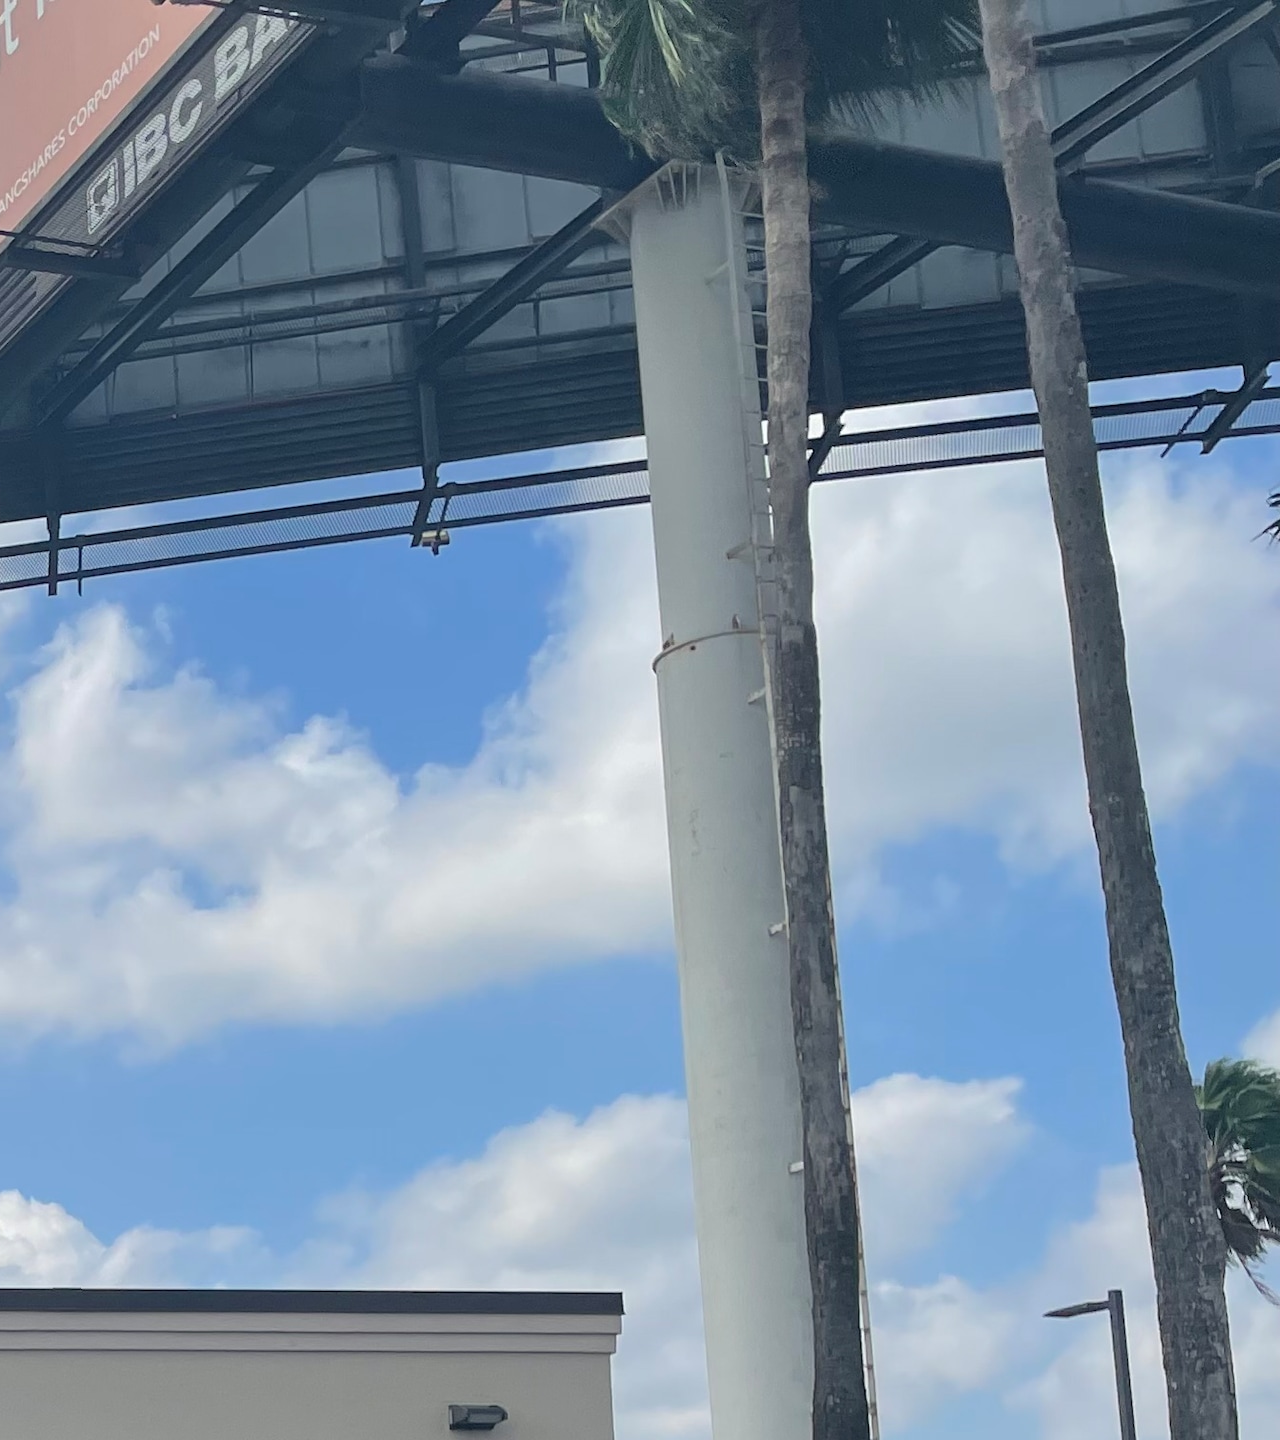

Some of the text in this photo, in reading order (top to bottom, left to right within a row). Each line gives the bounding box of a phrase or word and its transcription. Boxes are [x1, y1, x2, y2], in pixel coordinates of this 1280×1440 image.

[68, 23, 160, 137] CORPORATION
[123, 14, 299, 199] IBC BA
